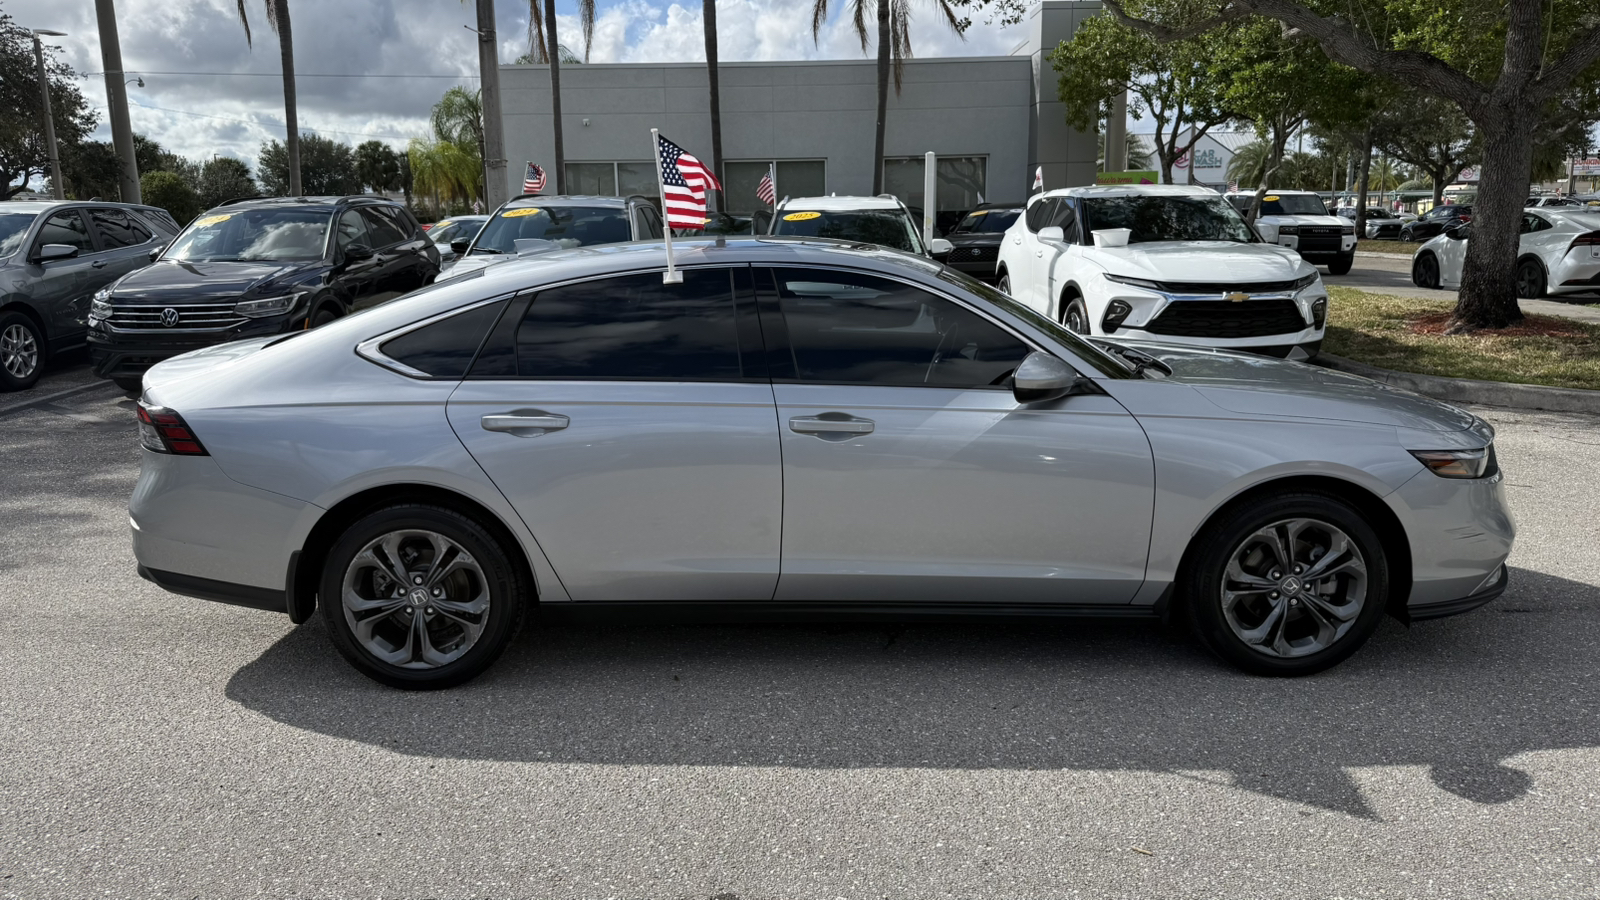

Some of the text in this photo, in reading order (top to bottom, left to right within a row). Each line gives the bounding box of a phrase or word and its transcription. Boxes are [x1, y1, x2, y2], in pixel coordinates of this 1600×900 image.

[1194, 149, 1215, 158] CAR
[1194, 156, 1222, 165] WASH
[790, 212, 814, 220] 2025
